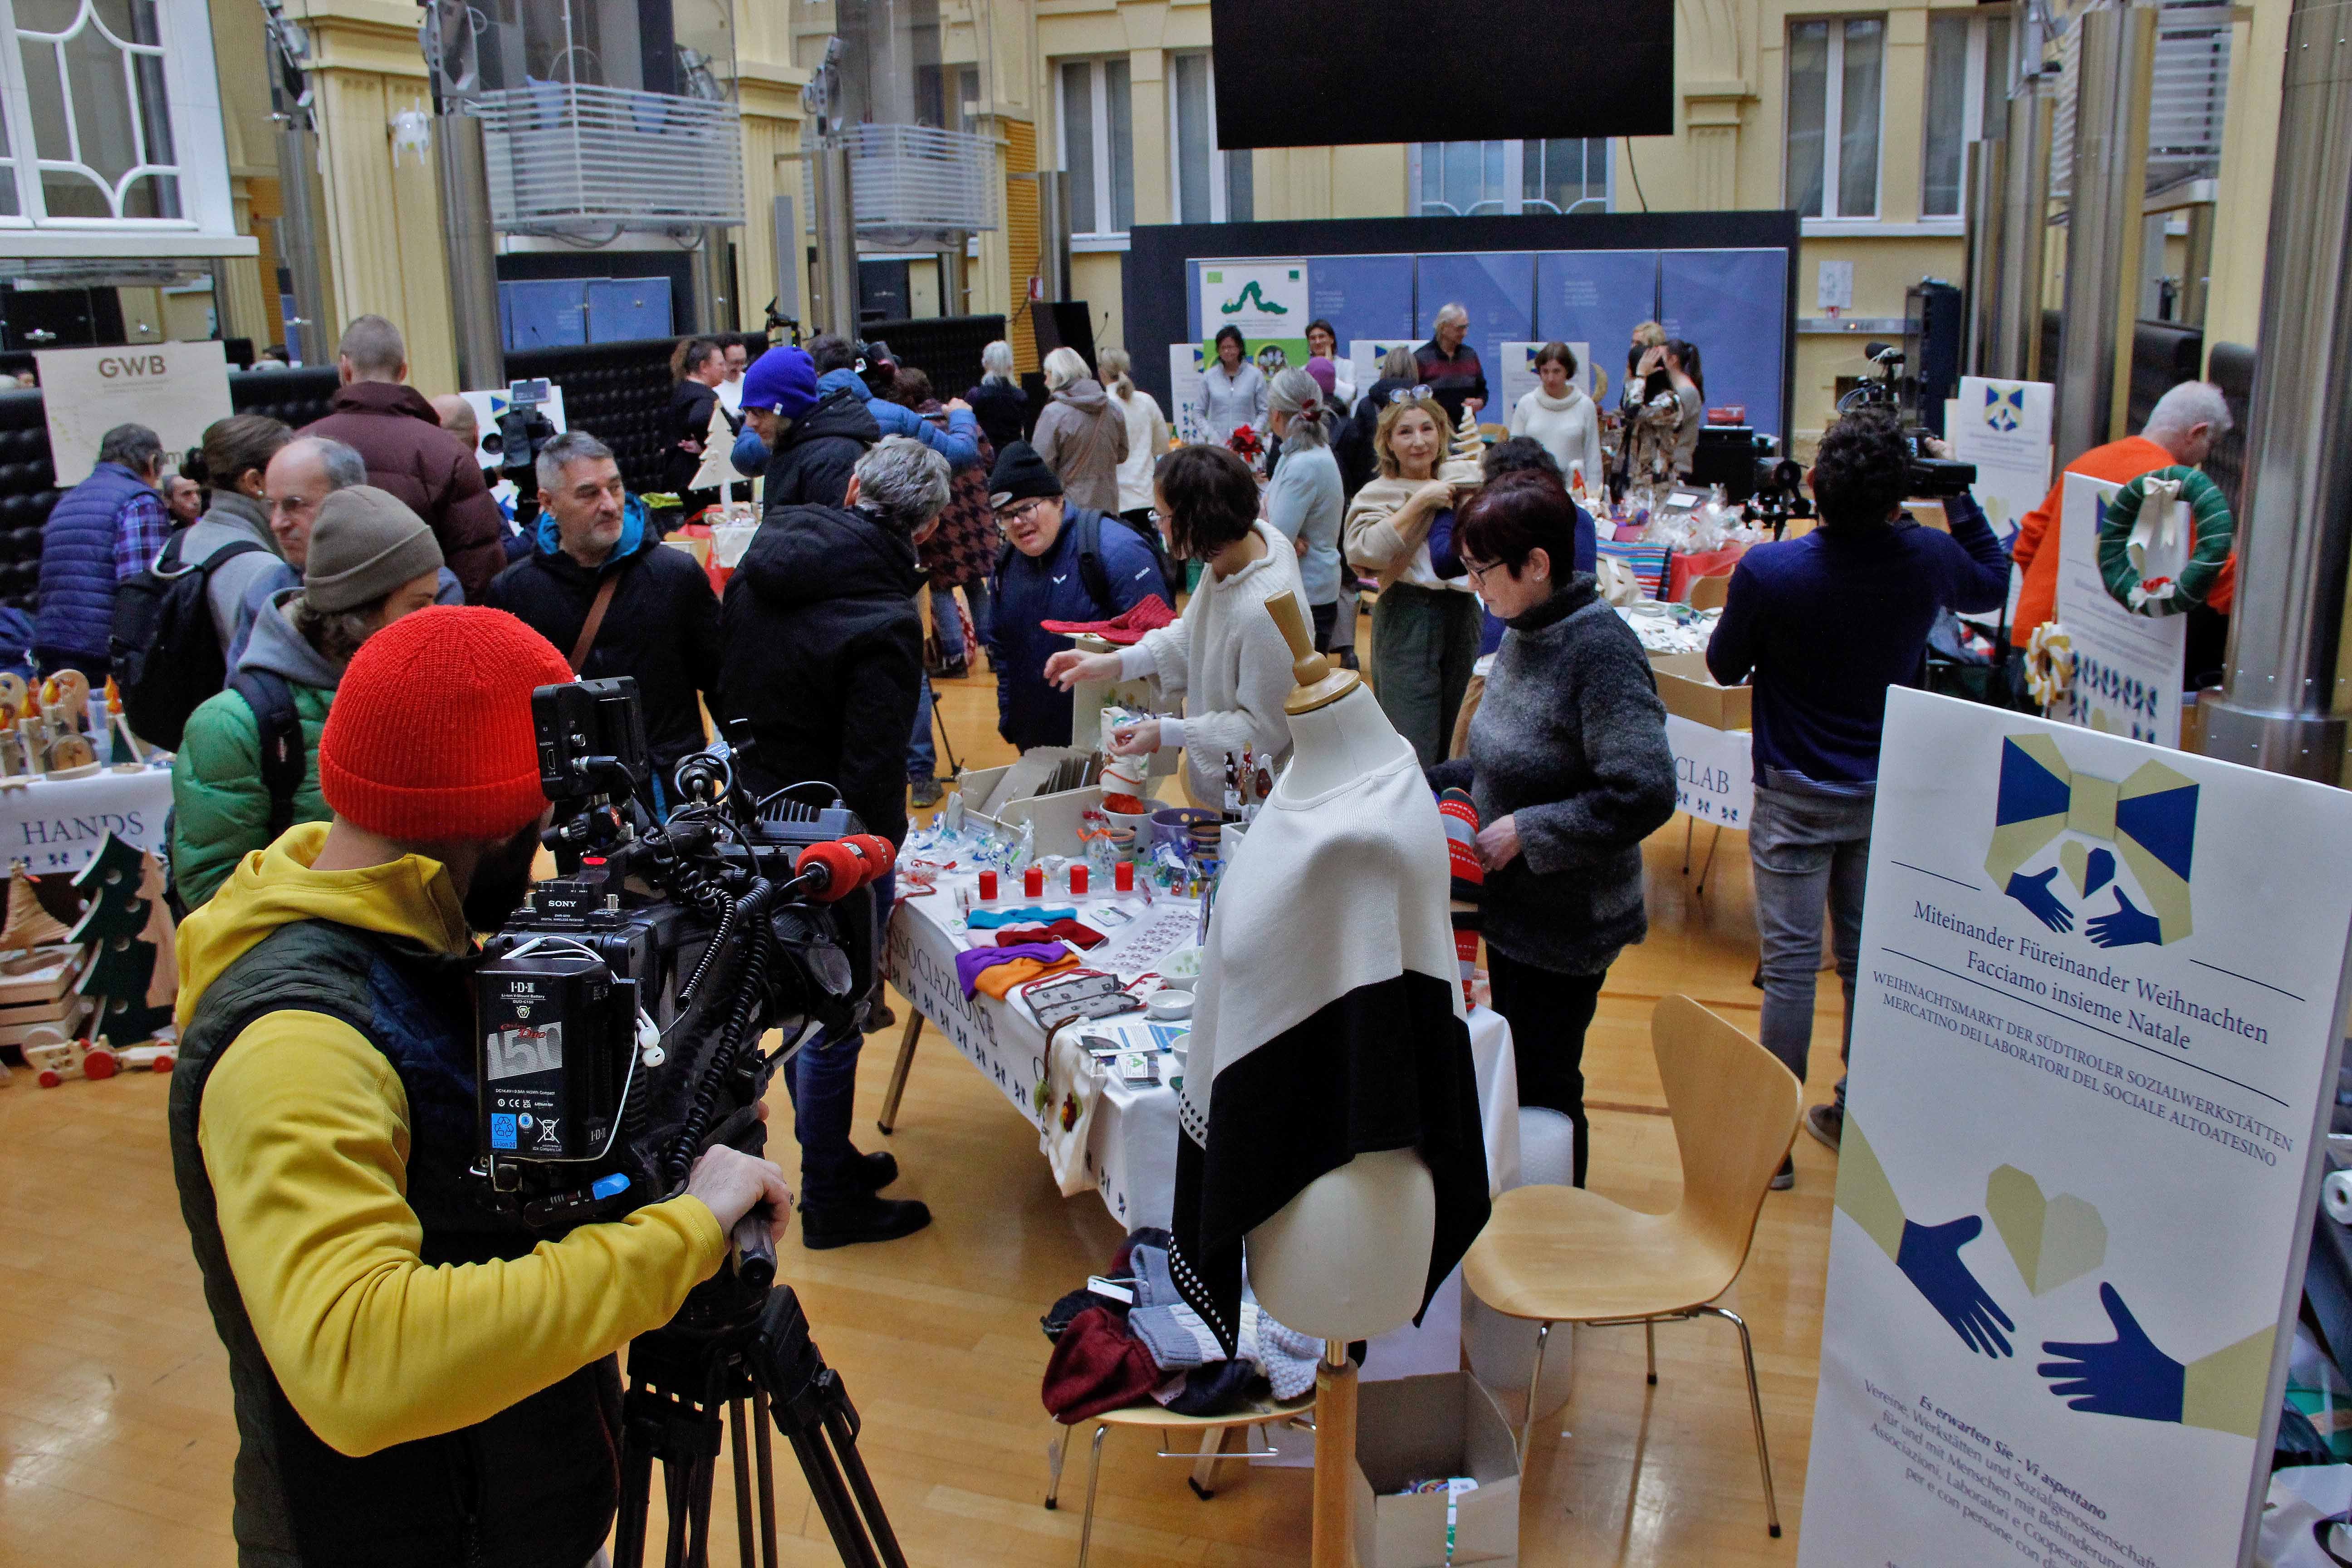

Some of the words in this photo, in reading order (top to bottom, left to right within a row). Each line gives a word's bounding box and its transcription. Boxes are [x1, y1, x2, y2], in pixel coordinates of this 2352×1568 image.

[99, 355, 168, 378] GWB
[21, 811, 145, 844] HANDS
[1914, 901, 2014, 951] Miteinander
[2019, 937, 2130, 992] Füreinander
[2136, 978, 2269, 1044] Weihnachten
[1967, 950, 2047, 995] Facciamo
[2051, 982, 2122, 1024] insieme
[2127, 1009, 2190, 1049] Natale
[1873, 970, 2004, 1030] WEIHNACHTSMARKT
[2007, 1022, 2033, 1044] DER
[2036, 1033, 2123, 1080] SÜDTIROLER
[2128, 1070, 2293, 1152] SOZIALWERKSTÄTTEN
[1883, 993, 1958, 1031] MERCATINO
[1960, 1023, 1982, 1042] DEI
[1984, 1033, 2069, 1079] LABORATORI
[2073, 1069, 2099, 1092] DEL
[2103, 1083, 2166, 1118] SOCIALE
[2169, 1111, 2277, 1167] ALTOATESINO
[1883, 1410, 1899, 1428] für
[1901, 1424, 1923, 1445] und
[1926, 1441, 1945, 1460] mit
[1947, 1452, 2012, 1501] Menschen
[2014, 1498, 2036, 1518] mit
[2039, 1509, 2124, 1568] Behinderun
[1906, 1467, 1925, 1485] per
[1937, 1489, 1960, 1510] con
[1962, 1504, 2013, 1544] persone
[2016, 1539, 2040, 1563] con
[1913, 1409, 1982, 1463] Werkstätten
[1985, 1458, 2011, 1480] und
[2014, 1473, 2159, 1568] Sozialgenossenschaft
[1920, 1395, 1932, 1411] Es
[1935, 1408, 1990, 1446] erwarten
[1994, 1440, 2014, 1460] Sie
[2026, 1459, 2040, 1475] Vi
[2041, 1473, 2107, 1519] aspettano
[1947, 1472, 2009, 1520] Laboratori
[2011, 1517, 2021, 1528] e
